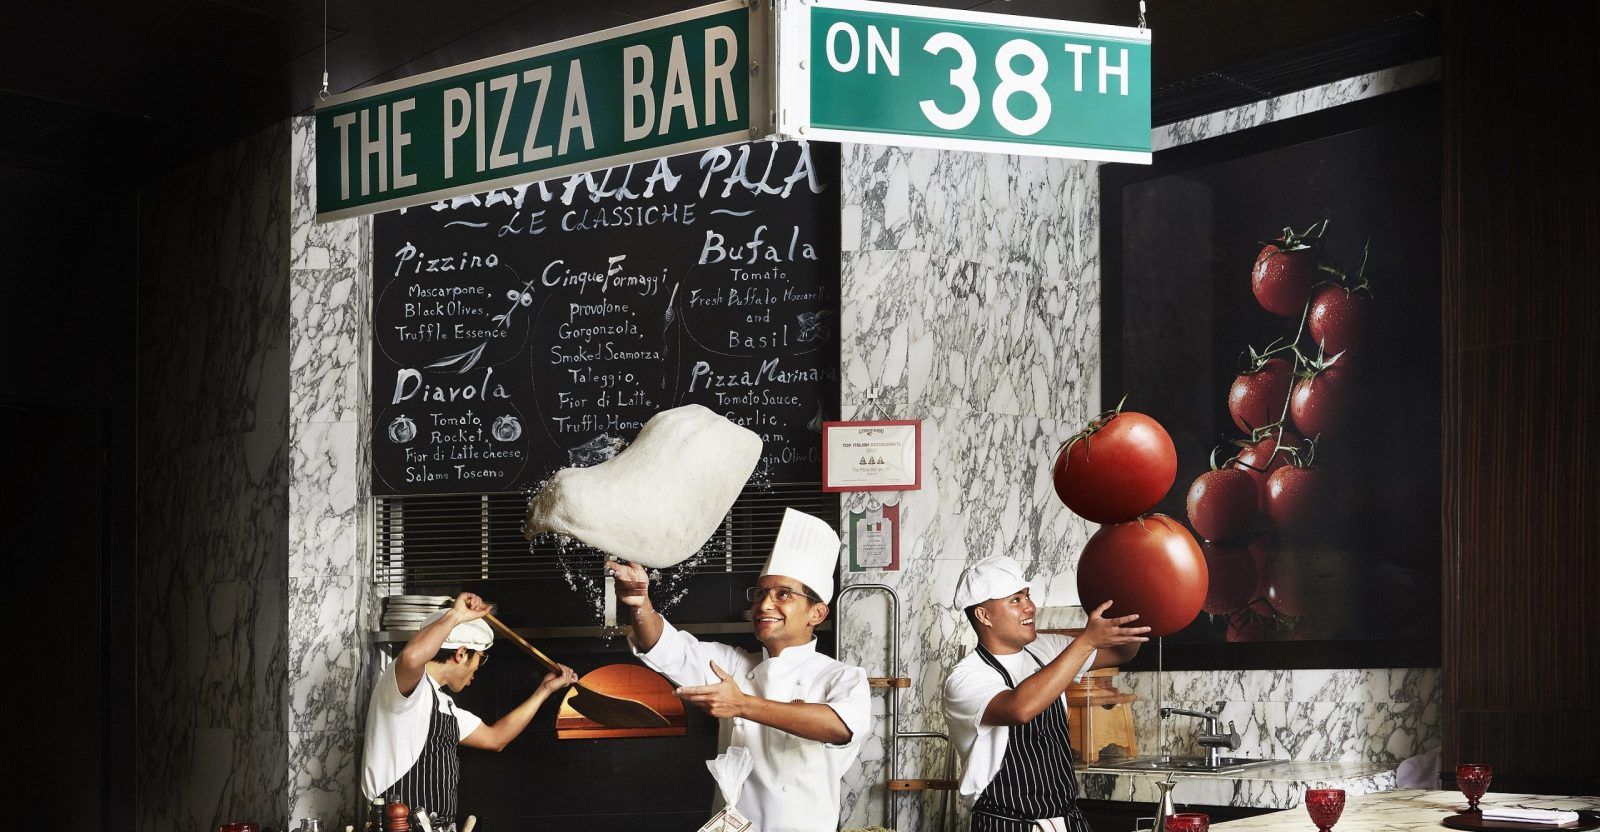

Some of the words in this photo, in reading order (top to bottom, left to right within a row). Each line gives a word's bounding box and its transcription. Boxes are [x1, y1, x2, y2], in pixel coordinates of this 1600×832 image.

[825, 21, 900, 77] ON
[333, 97, 418, 200] THE
[443, 59, 595, 179] PIZZA
[623, 25, 739, 143] BAR
[700, 140, 827, 199] PALA
[498, 210, 548, 238] LE
[561, 202, 697, 233] CLASSICHE
[699, 225, 819, 265] Bufala
[394, 241, 499, 277] Pizzino
[541, 259, 605, 295] Cinque
[601, 254, 668, 297] Formaggi
[408, 283, 493, 300] Mascarpone,
[690, 287, 724, 309] Fresh
[727, 286, 778, 308] Buffalo
[404, 303, 445, 319] Black
[746, 308, 771, 324] and
[394, 322, 448, 342] Truffle
[454, 323, 508, 340] Essence
[558, 320, 644, 343] Gorgonzola,
[729, 324, 788, 349] Basil
[550, 343, 601, 365] Smoked
[391, 366, 512, 405] Diavola
[568, 366, 639, 388] Taleggio,
[689, 360, 753, 393] Pizza
[558, 391, 588, 410] Fior
[597, 390, 611, 408] di
[617, 390, 660, 410] Latte,
[715, 389, 760, 407] Tomato
[552, 414, 604, 433] Truffle
[405, 447, 429, 462] Fior
[433, 446, 445, 461] di
[450, 444, 479, 461] Latte
[453, 464, 505, 481] Toscano
